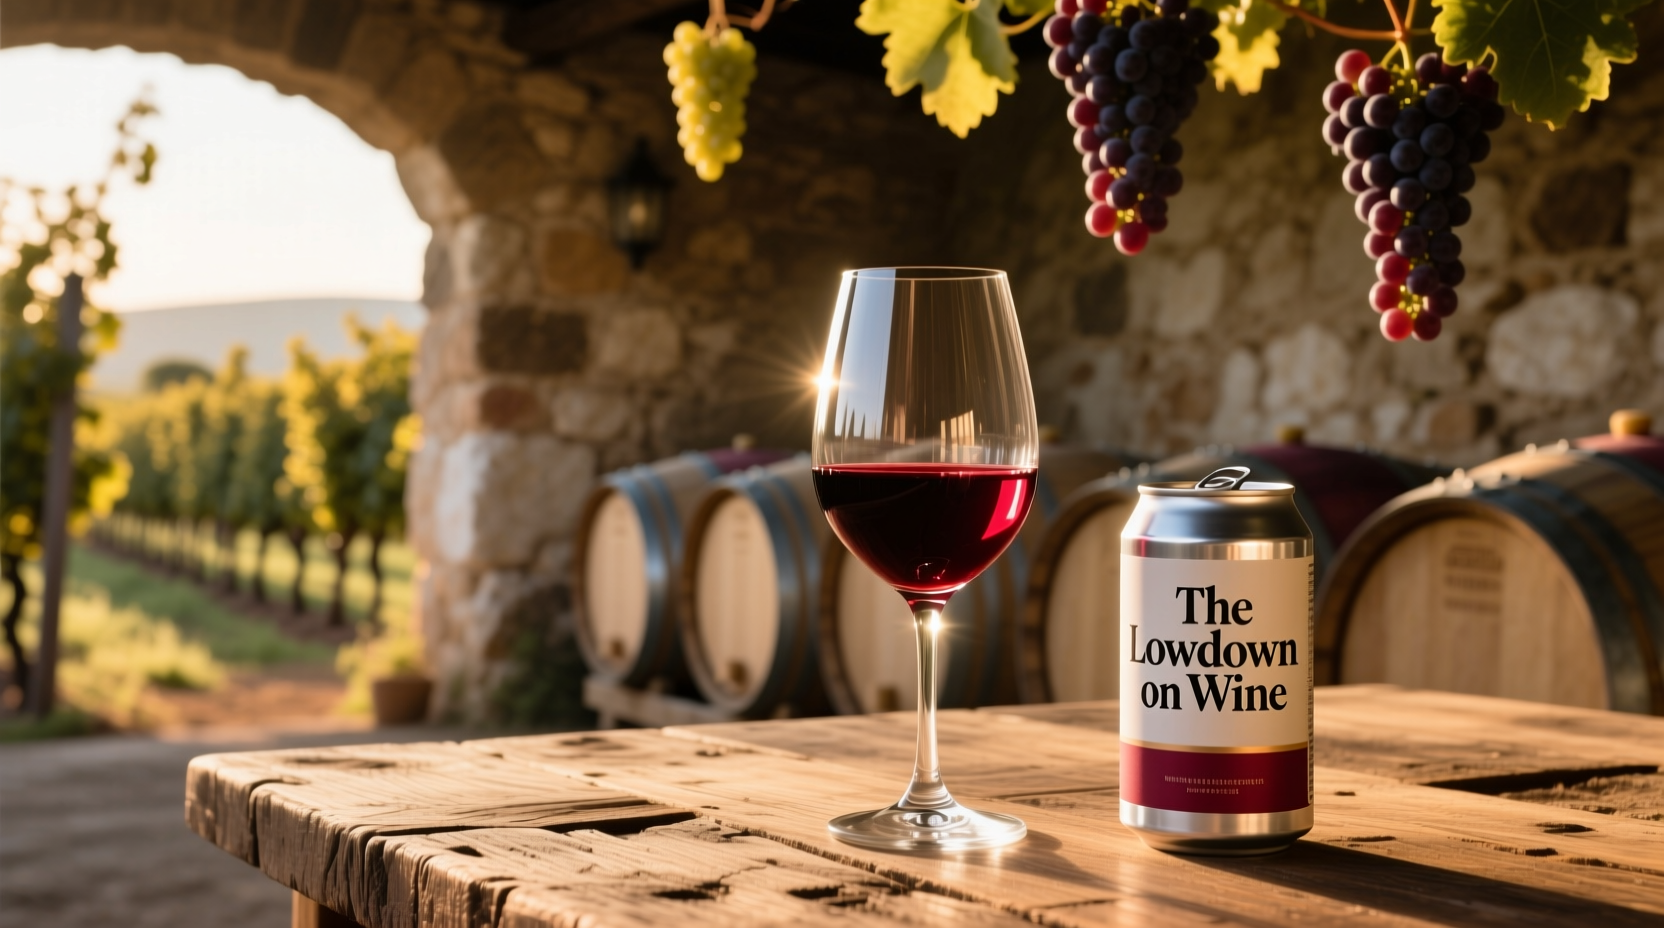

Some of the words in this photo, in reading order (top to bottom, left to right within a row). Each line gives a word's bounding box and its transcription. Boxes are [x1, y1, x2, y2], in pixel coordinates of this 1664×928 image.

[1175, 585, 1253, 625] The
[1130, 625, 1298, 668] Lowdown
[1141, 682, 1182, 710] on
[1186, 674, 1287, 712] Wine
